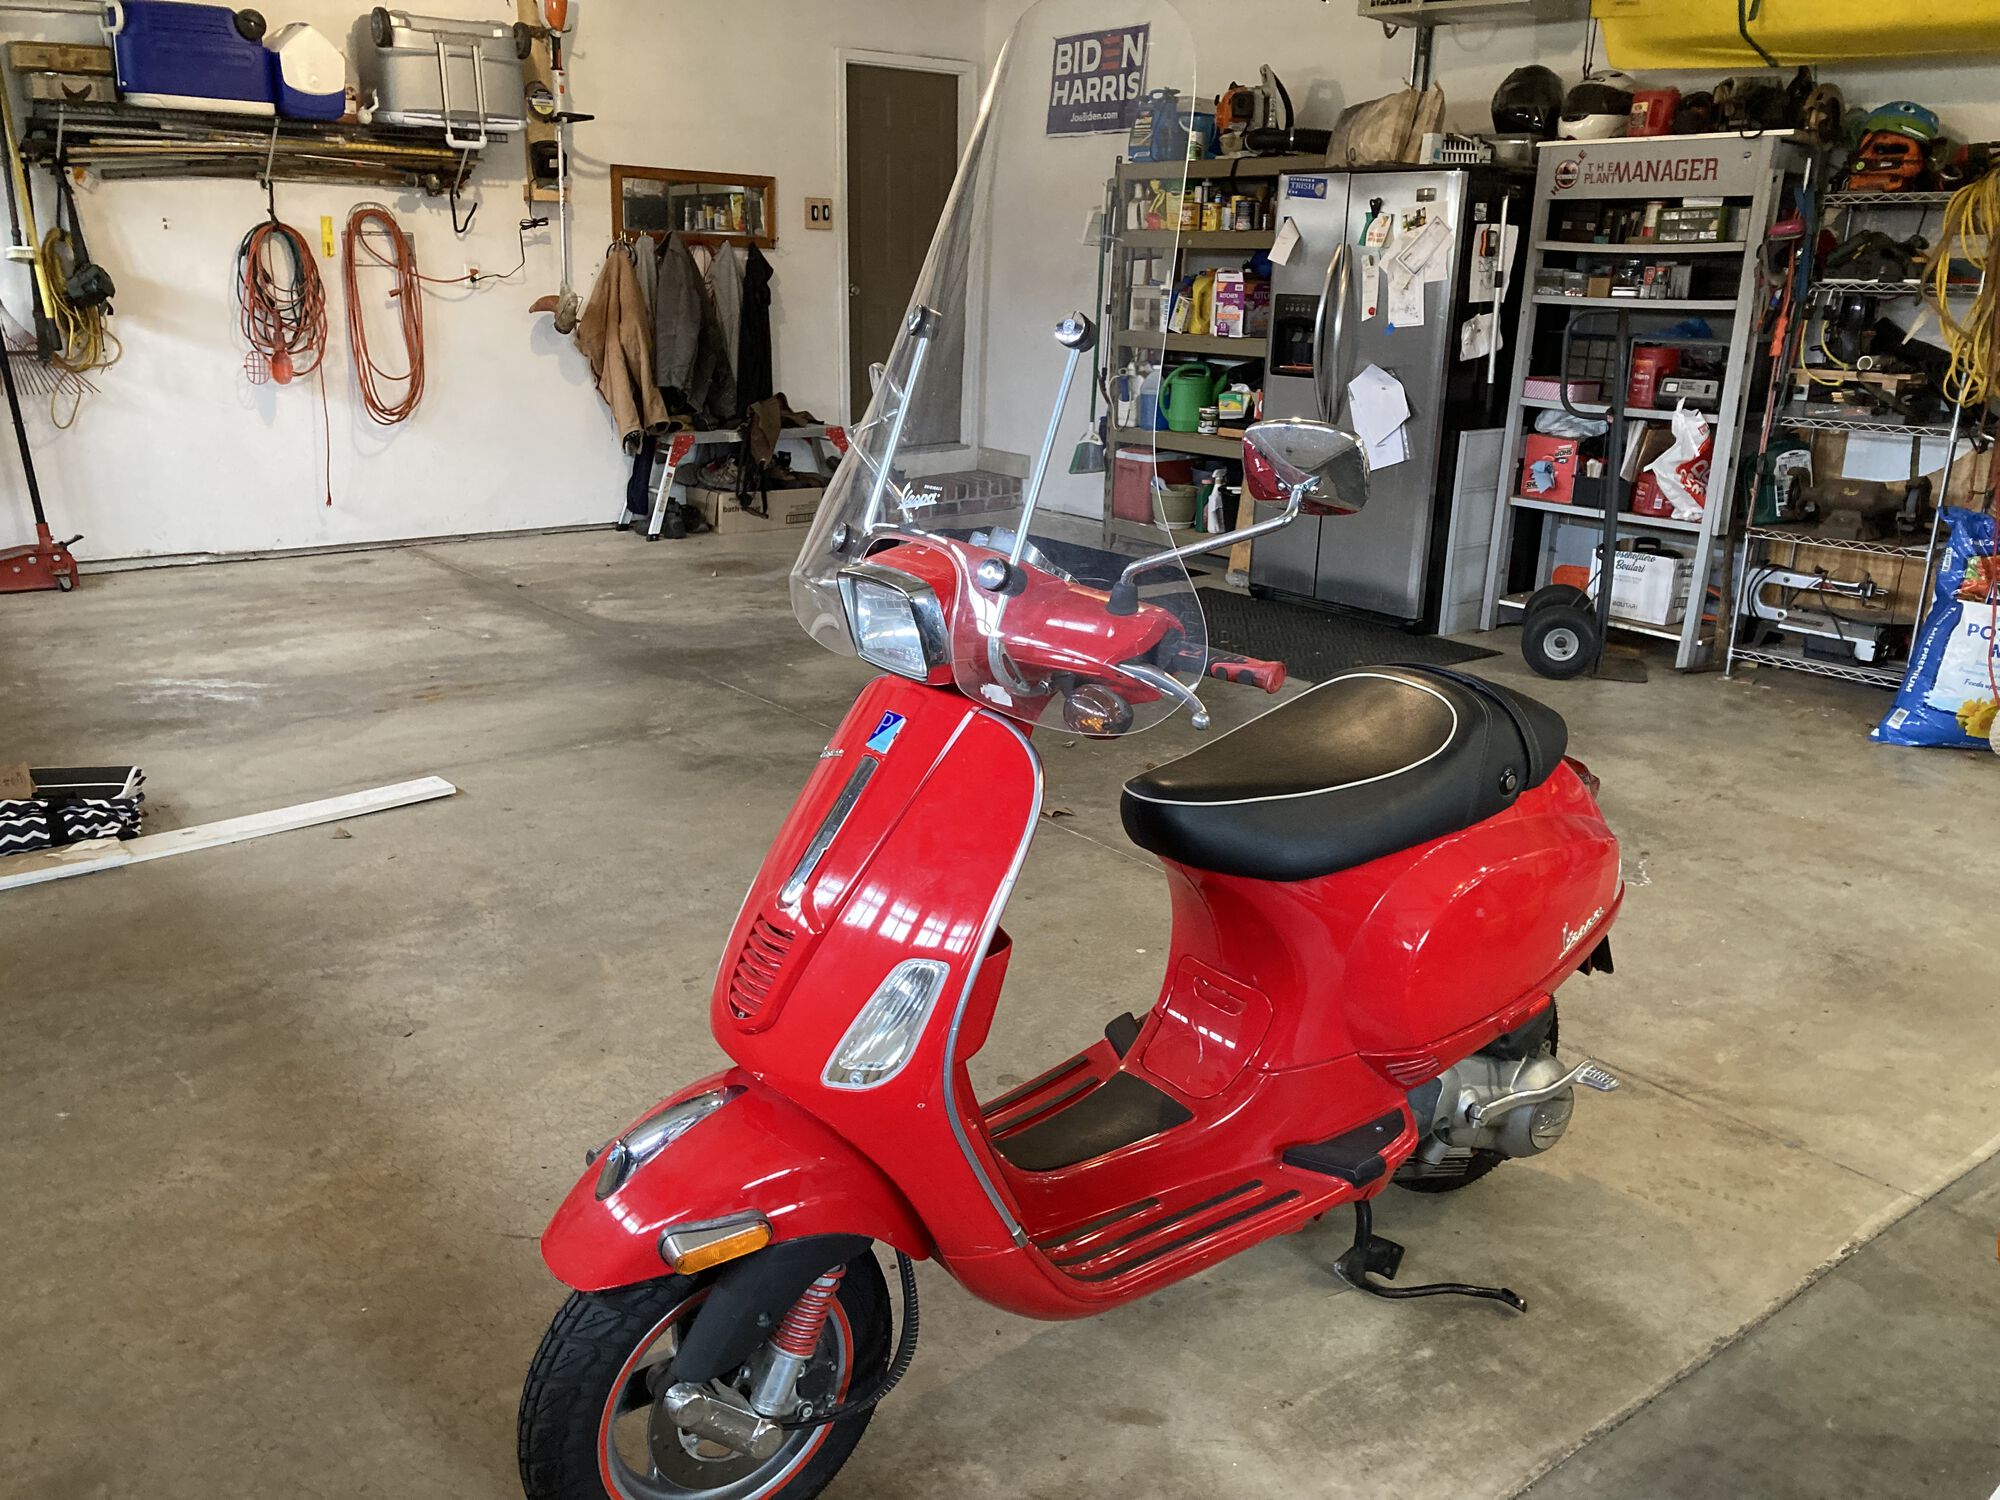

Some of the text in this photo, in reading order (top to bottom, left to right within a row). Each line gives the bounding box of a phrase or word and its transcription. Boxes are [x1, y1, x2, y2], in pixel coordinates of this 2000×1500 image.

[1055, 32, 1144, 76] BIDEN
[1052, 71, 1140, 106] HARRIS
[1587, 161, 1615, 172] THE
[1614, 157, 1719, 184] MANAGER
[1584, 172, 1616, 184] PLANT
[722, 504, 740, 513] bath
[1615, 559, 1646, 573] Boutari
[1925, 626, 1940, 648] MIX
[1967, 622, 2000, 641] PO
[1905, 647, 1931, 694] PREMIUM
